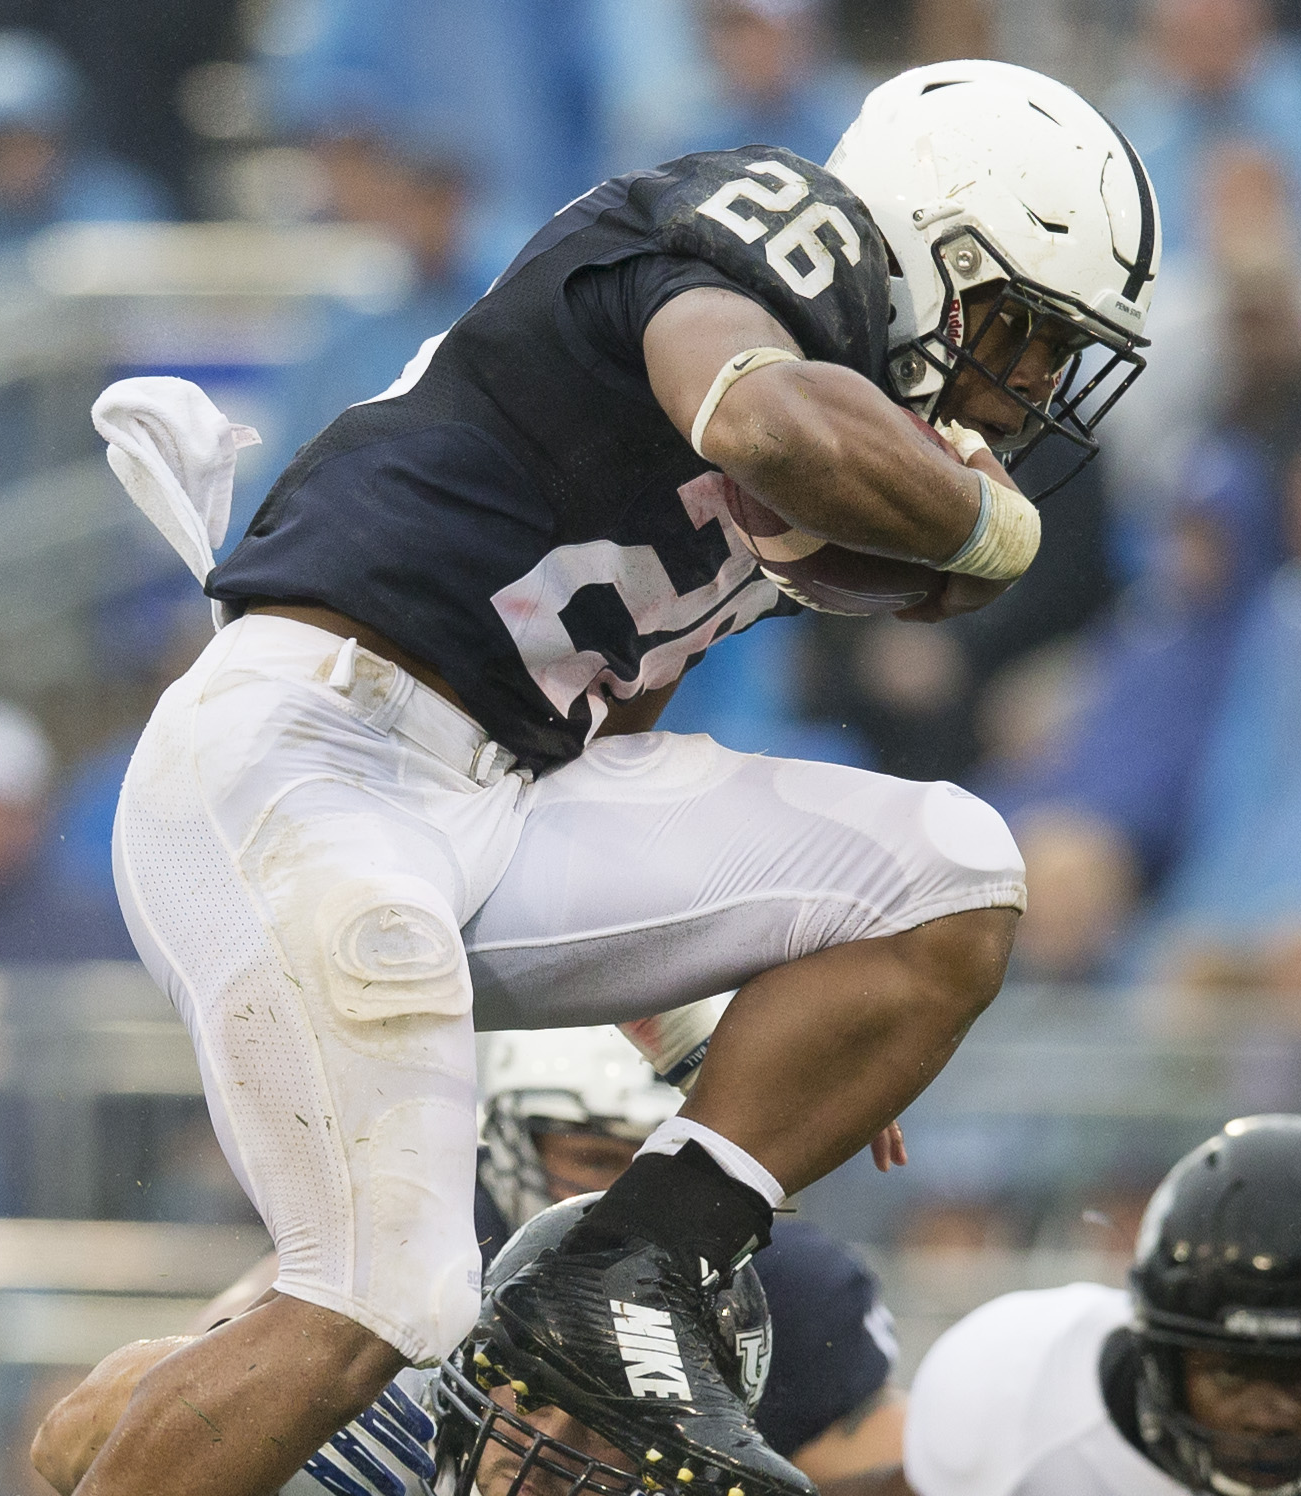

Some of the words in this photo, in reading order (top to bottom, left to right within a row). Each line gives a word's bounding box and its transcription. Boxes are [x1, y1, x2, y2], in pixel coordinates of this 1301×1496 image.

[696, 161, 861, 300] 26
[1115, 301, 1129, 314] PENN
[609, 1299, 694, 1401] NIKE
